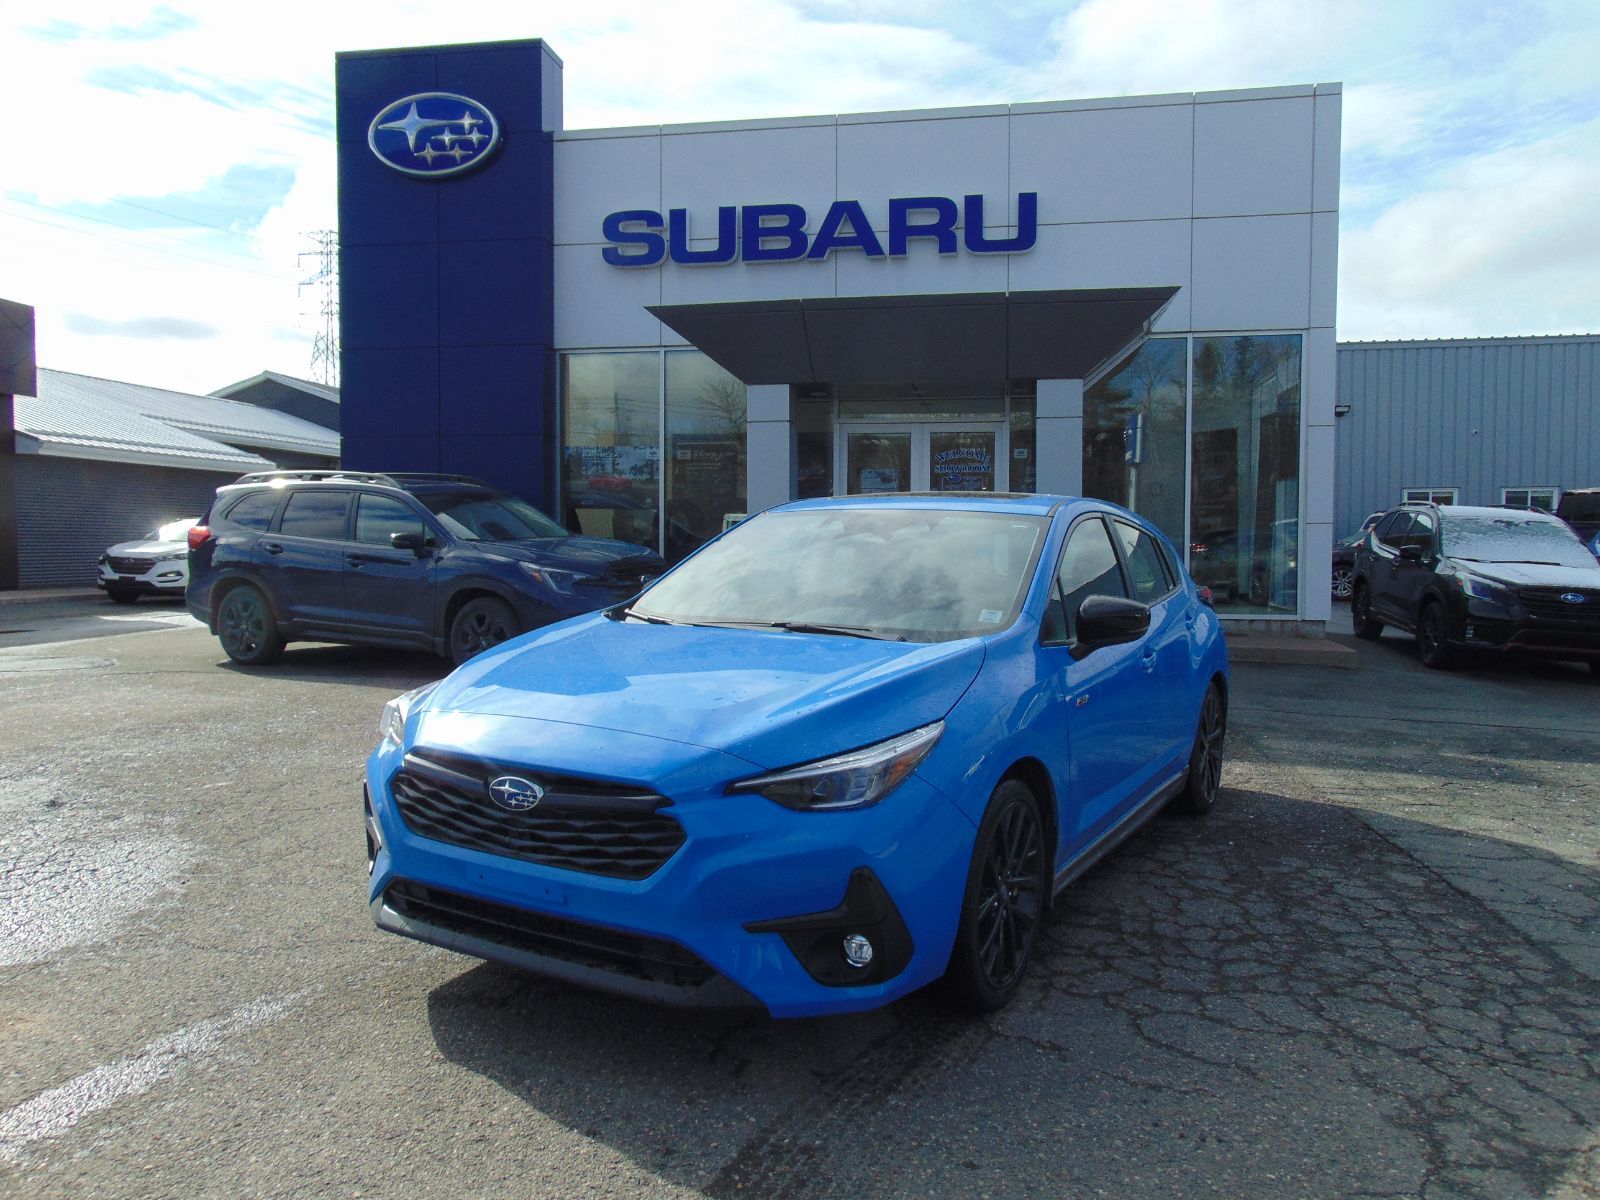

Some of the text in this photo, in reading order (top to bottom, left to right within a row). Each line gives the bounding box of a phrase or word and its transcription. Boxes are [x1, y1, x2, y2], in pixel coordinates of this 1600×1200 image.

[602, 192, 1038, 267] SUBARU
[935, 448, 991, 463] WELCOME
[935, 464, 991, 473] SHOWROOM
